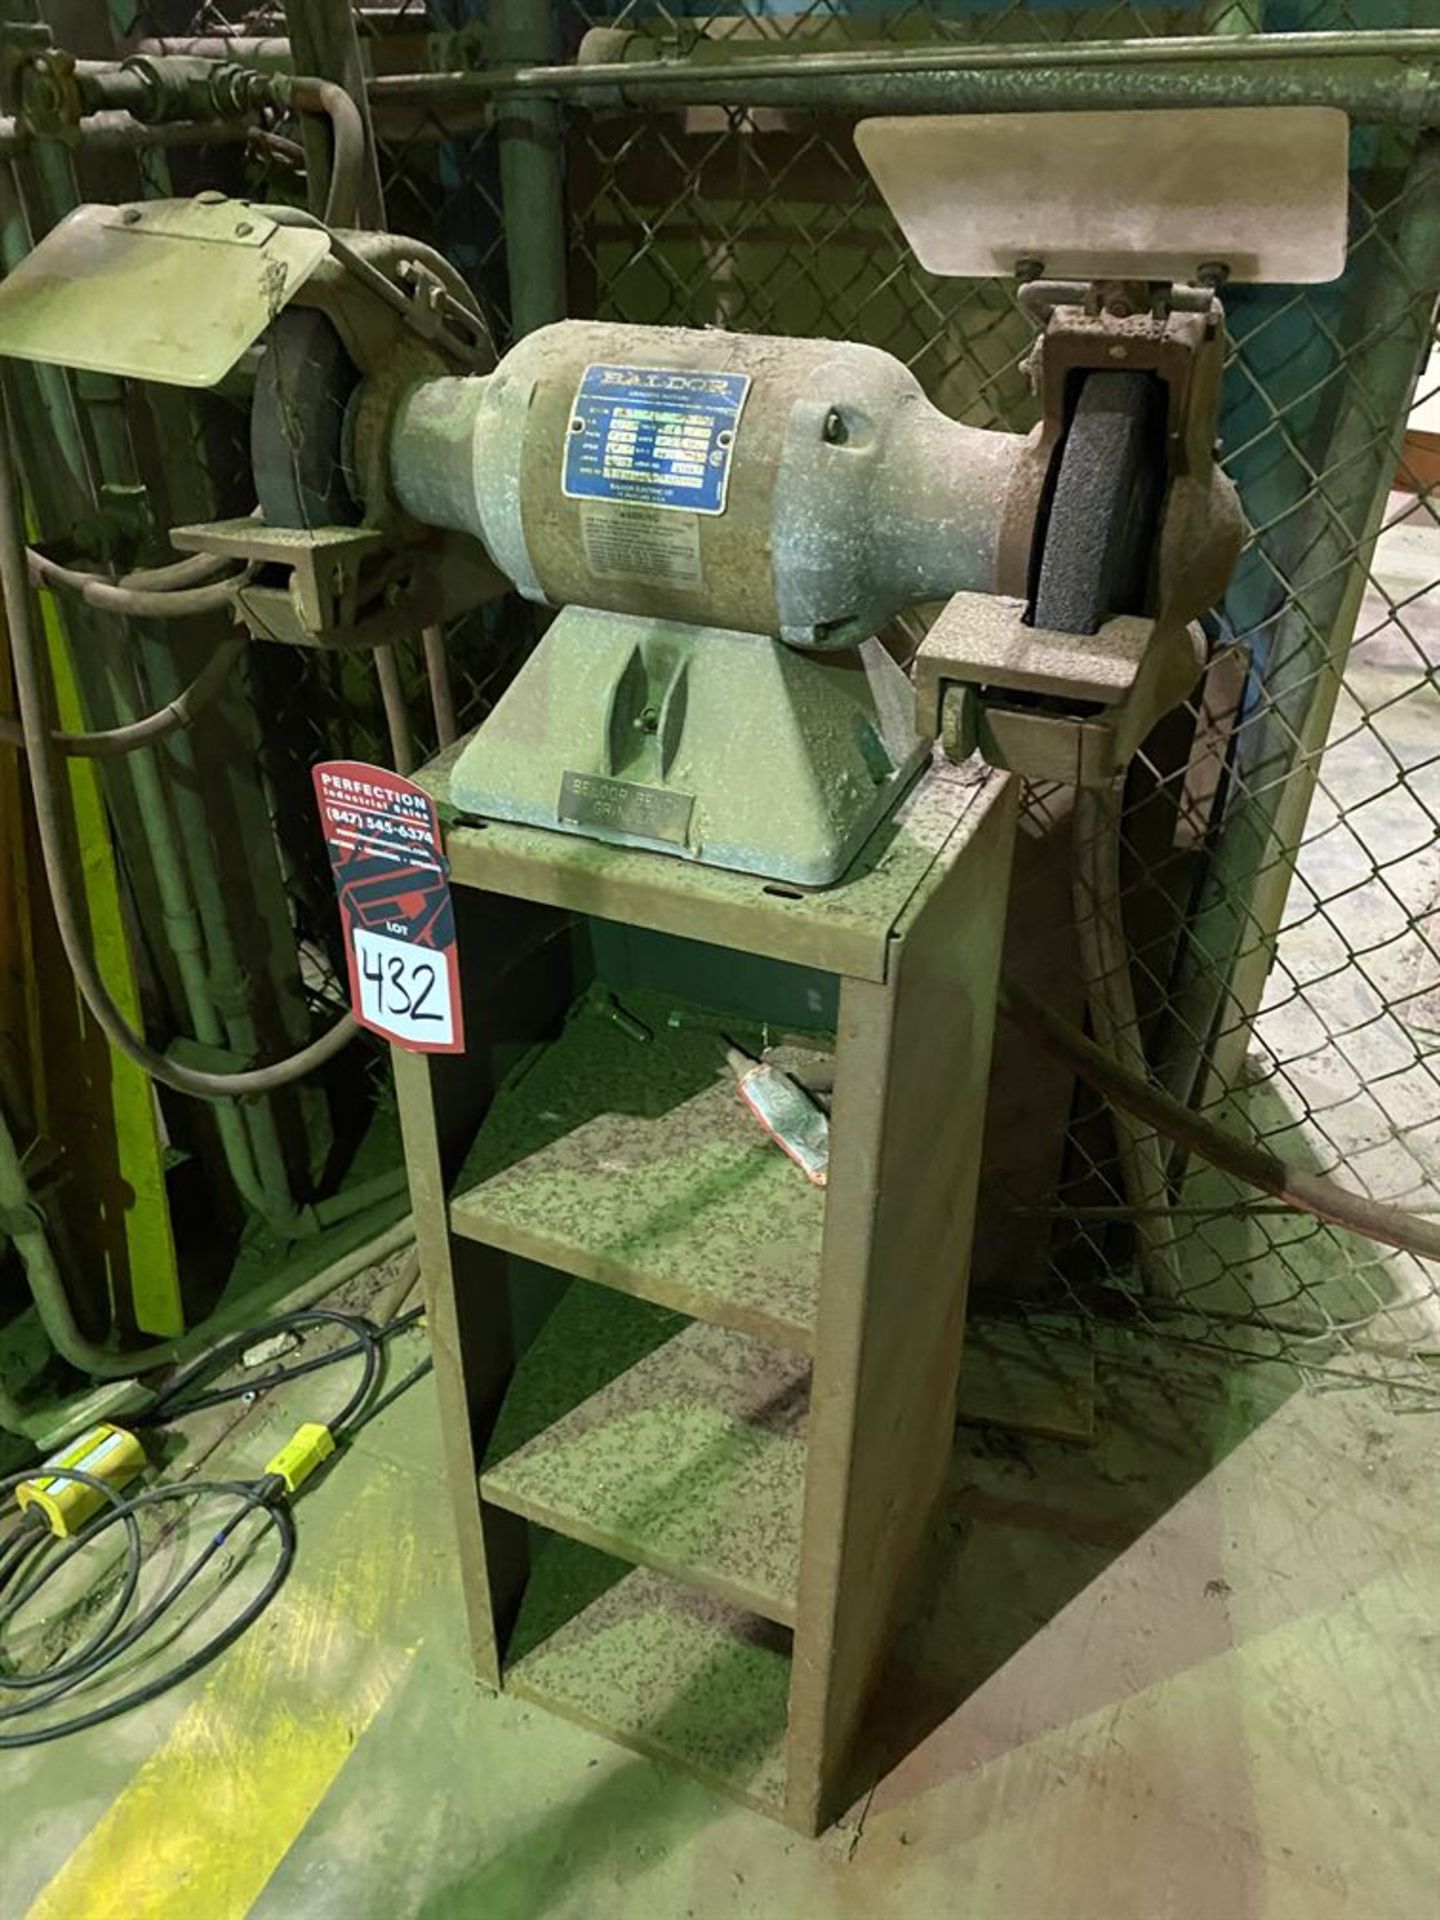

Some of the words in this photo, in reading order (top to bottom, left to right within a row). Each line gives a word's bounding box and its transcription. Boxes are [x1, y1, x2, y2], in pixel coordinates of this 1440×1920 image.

[321, 773, 427, 809] PERFECTION
[323, 787, 388, 811] Industrial
[393, 804, 429, 820] Sales
[326, 807, 363, 828] (847)
[386, 921, 408, 935] LOT
[362, 947, 444, 1021] 432
